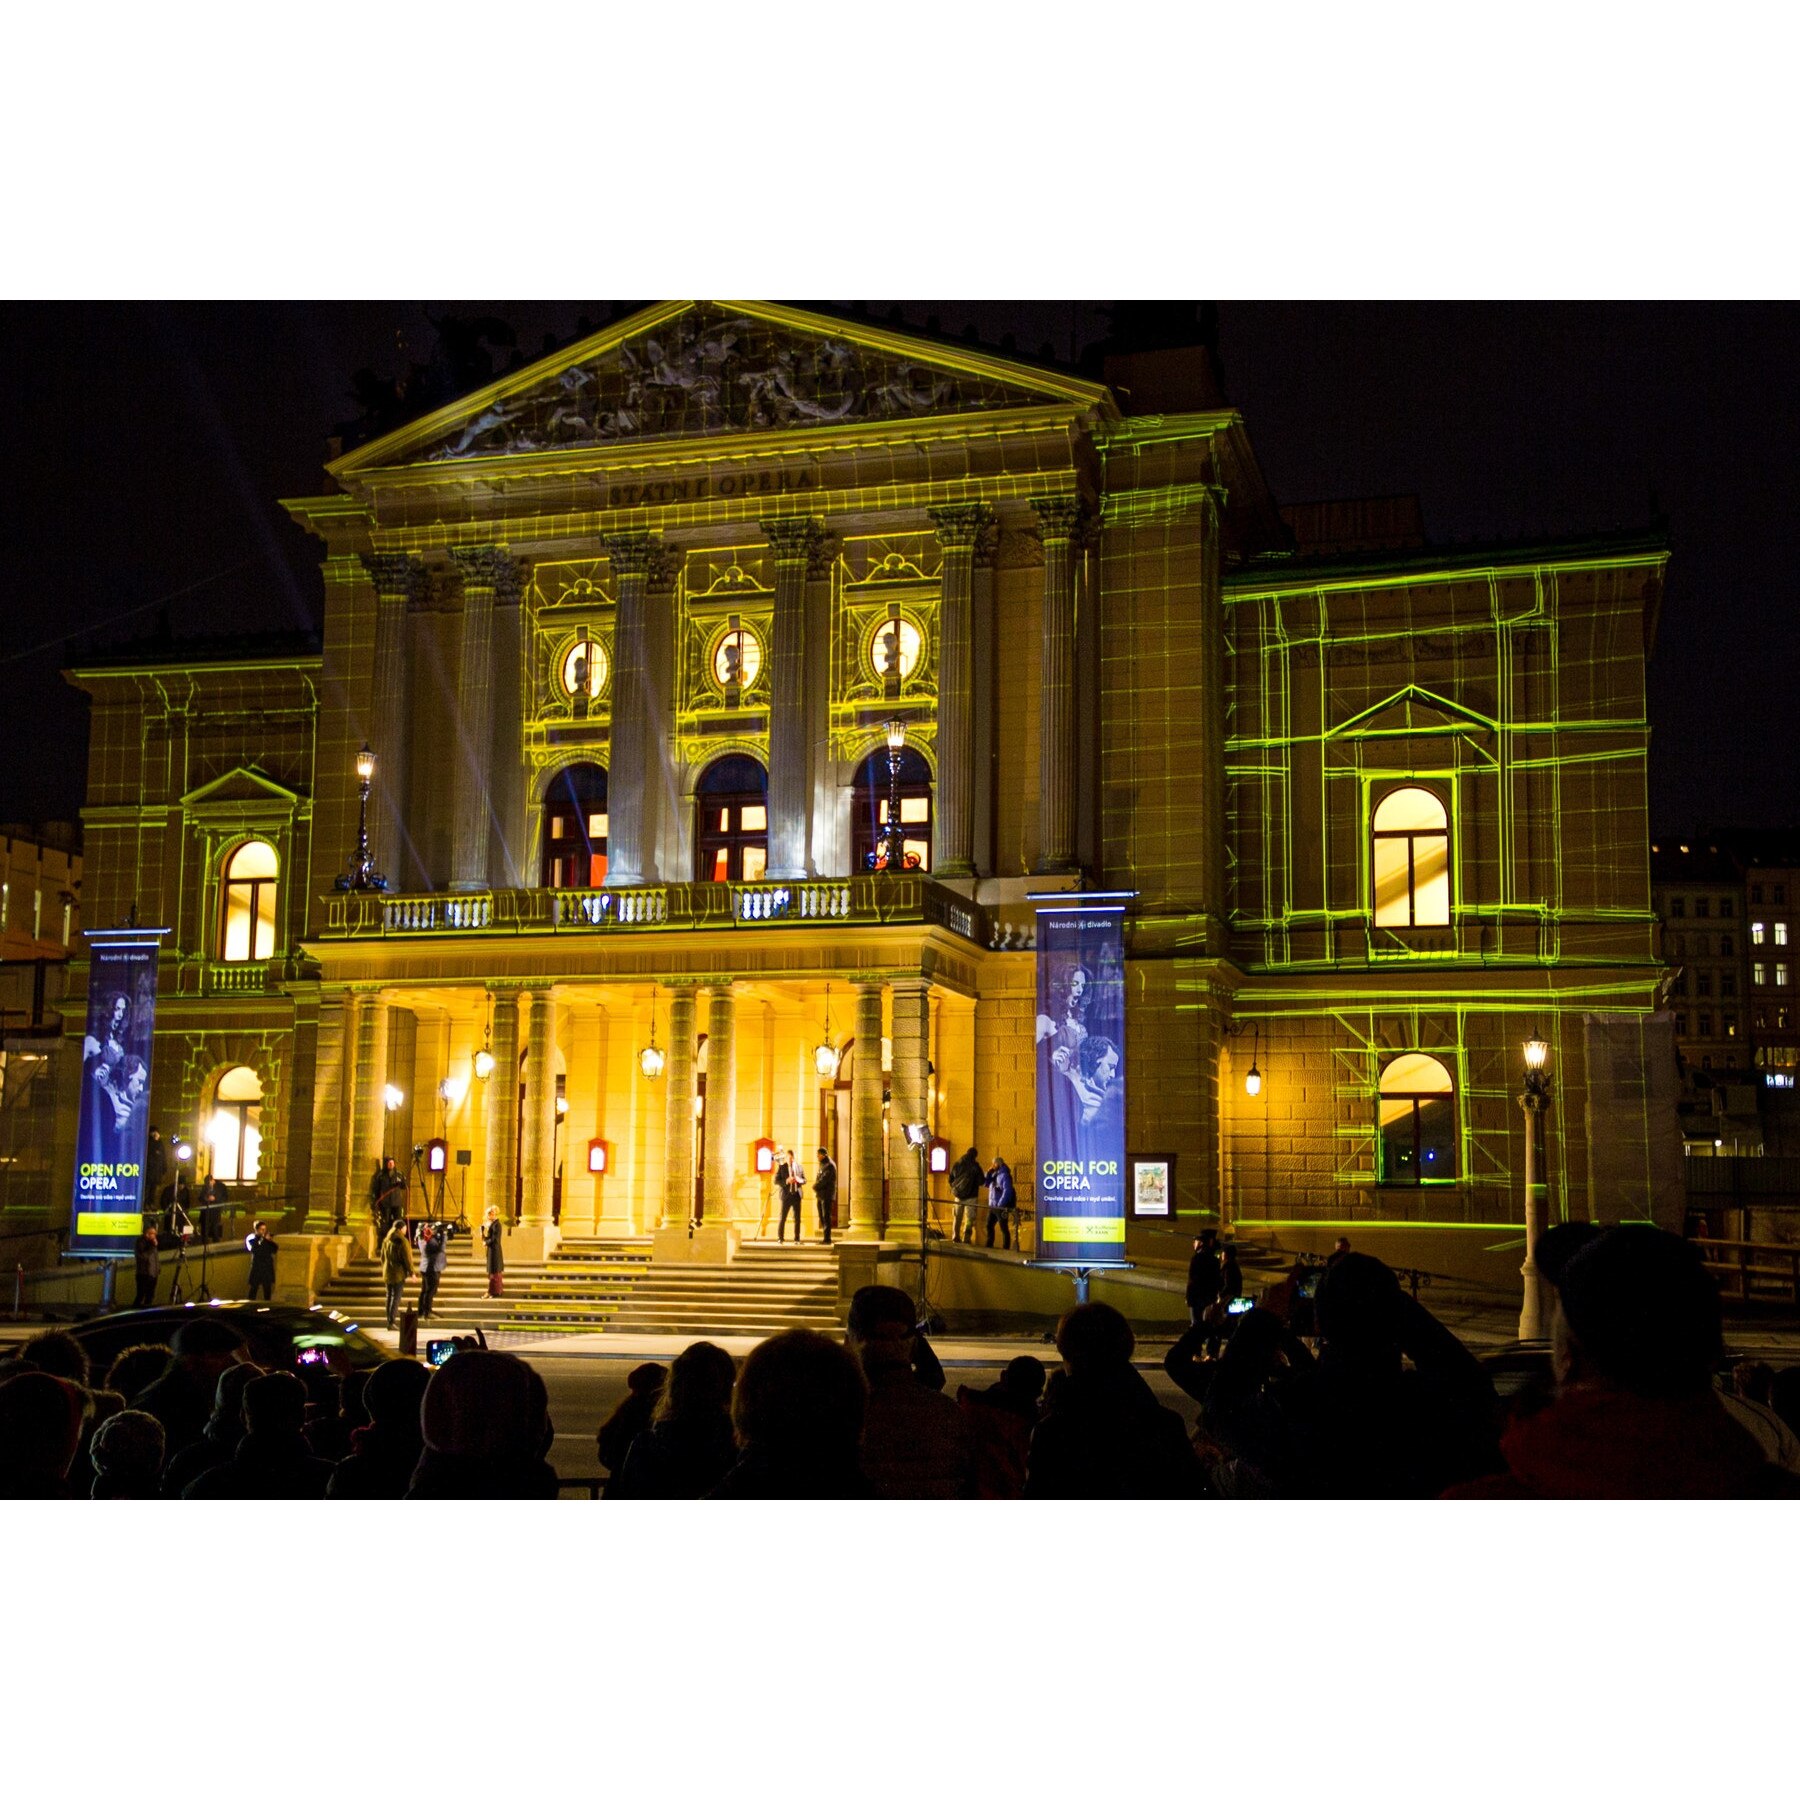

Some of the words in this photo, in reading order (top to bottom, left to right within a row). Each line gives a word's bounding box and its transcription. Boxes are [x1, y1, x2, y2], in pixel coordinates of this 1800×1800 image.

[718, 469, 812, 495] OPERA
[1087, 920, 1112, 929] divadlo
[80, 1163, 114, 1177] OPEN
[116, 1163, 140, 1177] FOR
[1043, 1160, 1084, 1175] OPEN
[1088, 1160, 1118, 1175] FOR
[80, 1176, 118, 1190] OPERA
[1043, 1175, 1091, 1190] OPERA
